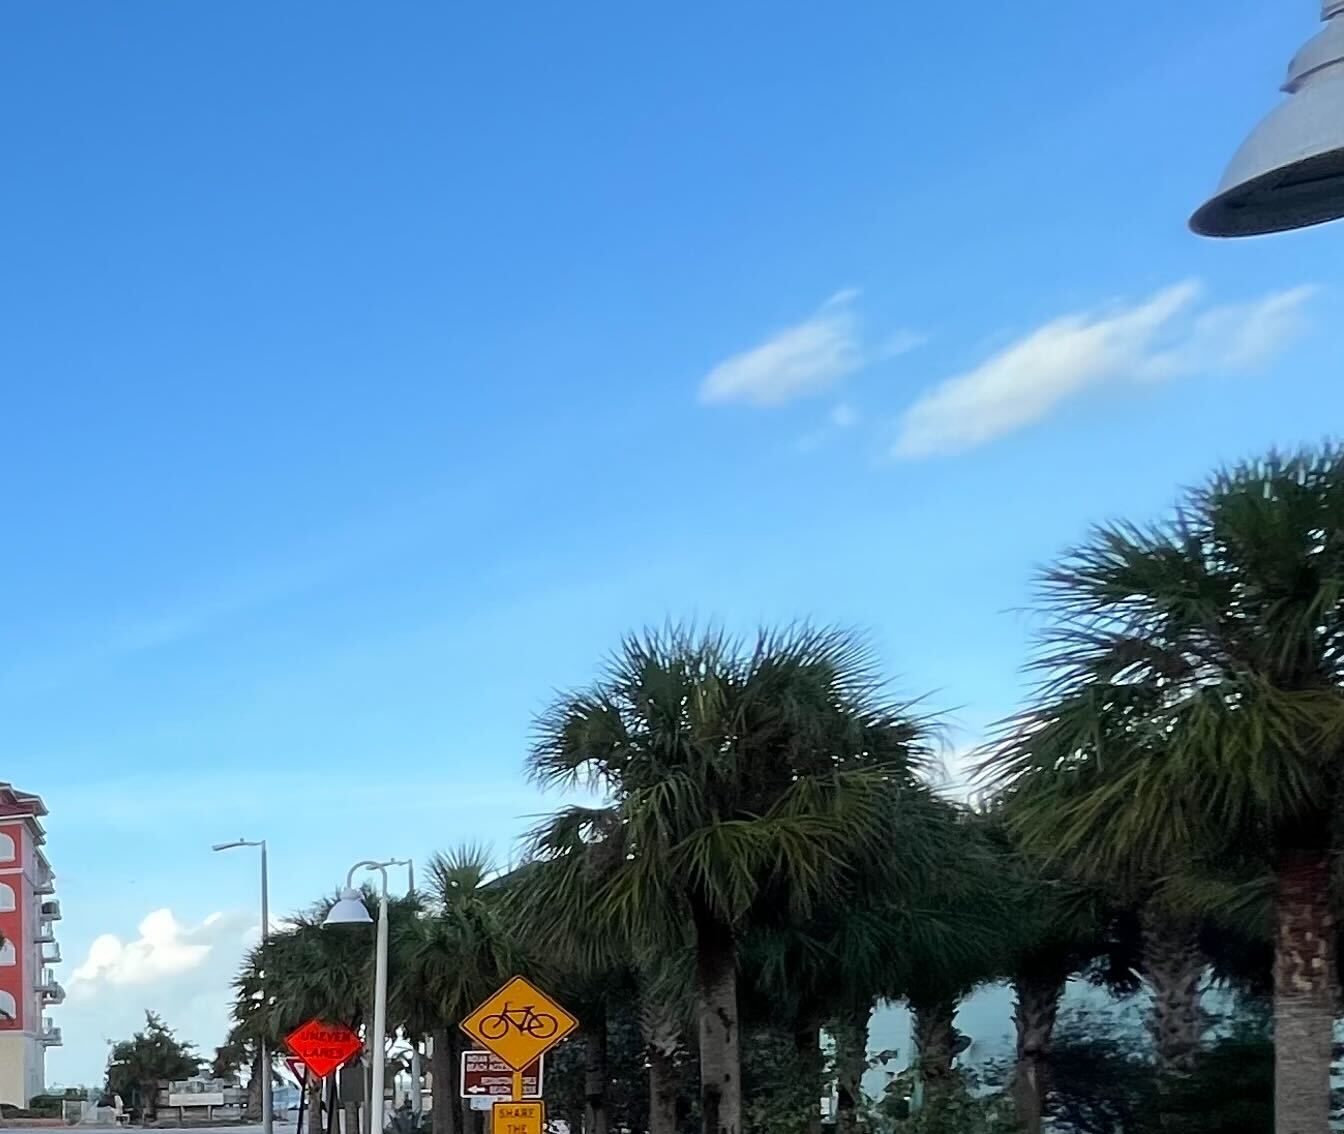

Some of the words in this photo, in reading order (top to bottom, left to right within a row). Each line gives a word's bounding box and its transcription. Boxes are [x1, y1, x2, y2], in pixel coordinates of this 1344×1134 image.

[300, 1031, 351, 1043] UNEVEN
[303, 1047, 345, 1059] LANES
[499, 1108, 535, 1119] SHARE
[507, 1124, 528, 1134] THE
